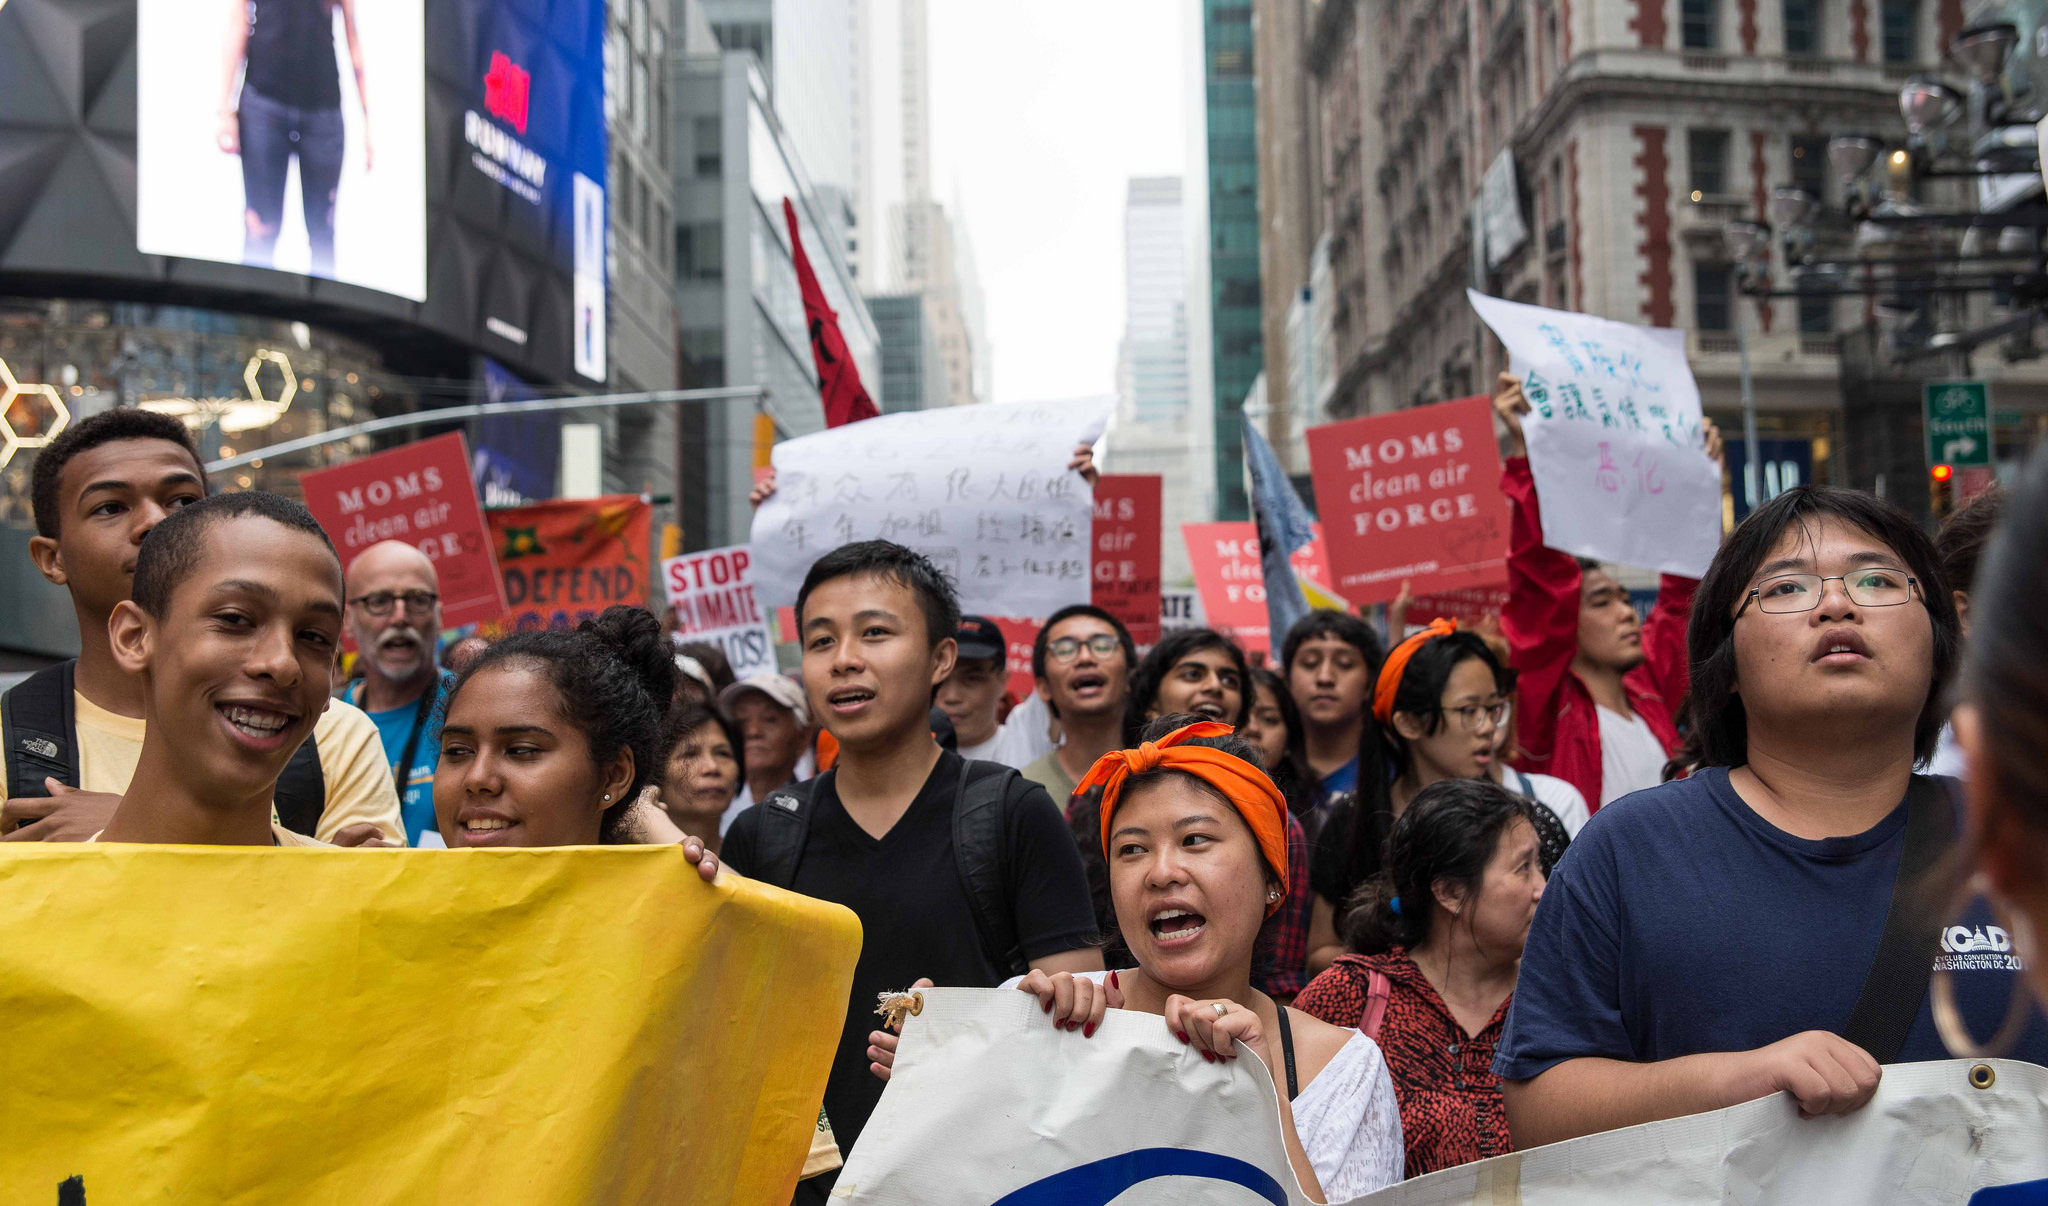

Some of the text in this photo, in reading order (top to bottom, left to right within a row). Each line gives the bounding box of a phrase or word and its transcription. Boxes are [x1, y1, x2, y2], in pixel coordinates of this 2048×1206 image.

[1929, 417, 1986, 436] South
[1345, 427, 1463, 471] MOMS
[336, 466, 443, 514] MOMS
[1350, 459, 1470, 503] clean air
[344, 513, 409, 547] clean
[413, 498, 451, 529] air
[1092, 497, 1135, 521] MS
[1354, 494, 1477, 536] FORCE
[1098, 526, 1137, 552] air
[505, 565, 633, 605] DEFEND
[670, 551, 750, 592] STOP
[675, 586, 761, 634] CLIMATE
[22, 739, 45, 751] NORTH
[1933, 960, 1992, 971] WASHINGTON
[1993, 961, 2004, 970] DC
[1963, 953, 2002, 961] CONVENTION
